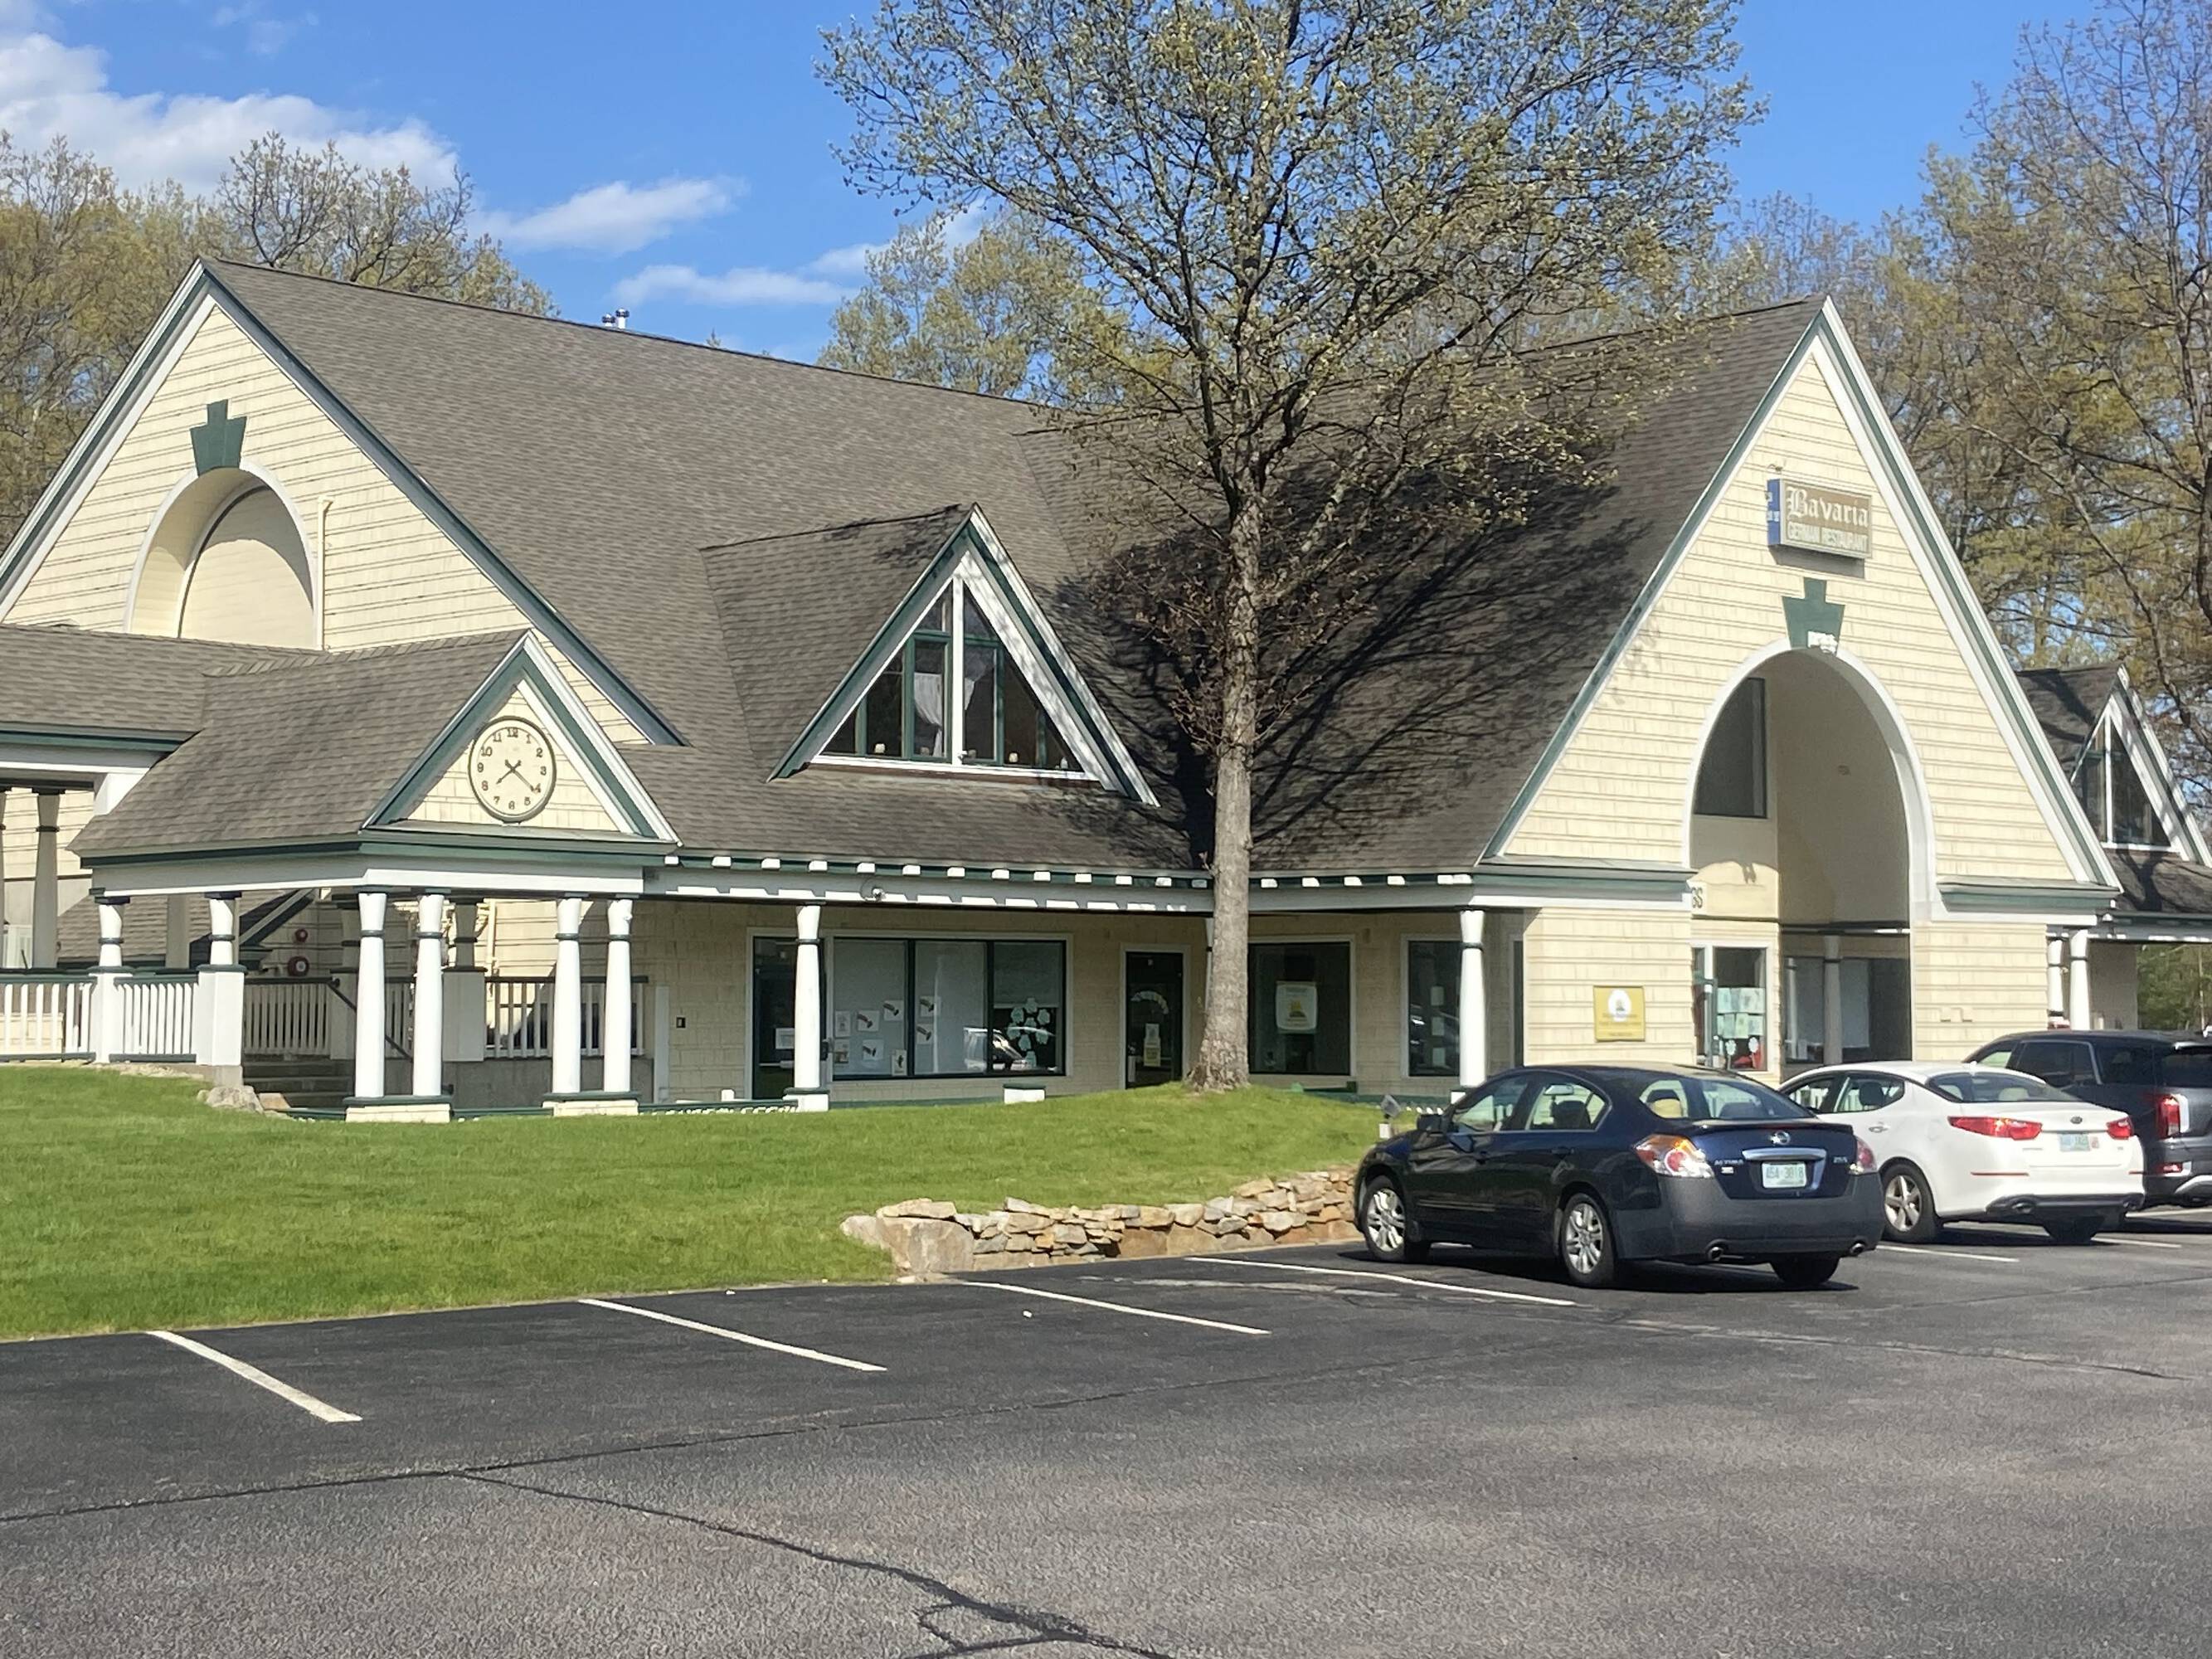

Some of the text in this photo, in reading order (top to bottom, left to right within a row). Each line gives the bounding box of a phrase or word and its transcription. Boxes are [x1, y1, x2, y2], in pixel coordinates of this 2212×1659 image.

[1787, 486, 1869, 527] Bavaria
[493, 732, 502, 742] 11
[507, 728, 518, 737] 12
[526, 733, 532, 744] 1
[481, 747, 493, 757] 10
[536, 747, 543, 757] 2
[477, 762, 484, 772] 9
[540, 766, 547, 776] 3
[481, 781, 489, 791] 8
[534, 783, 542, 794] 4
[493, 796, 500, 805] 7
[508, 800, 515, 810] 6
[524, 797, 531, 805] 5
